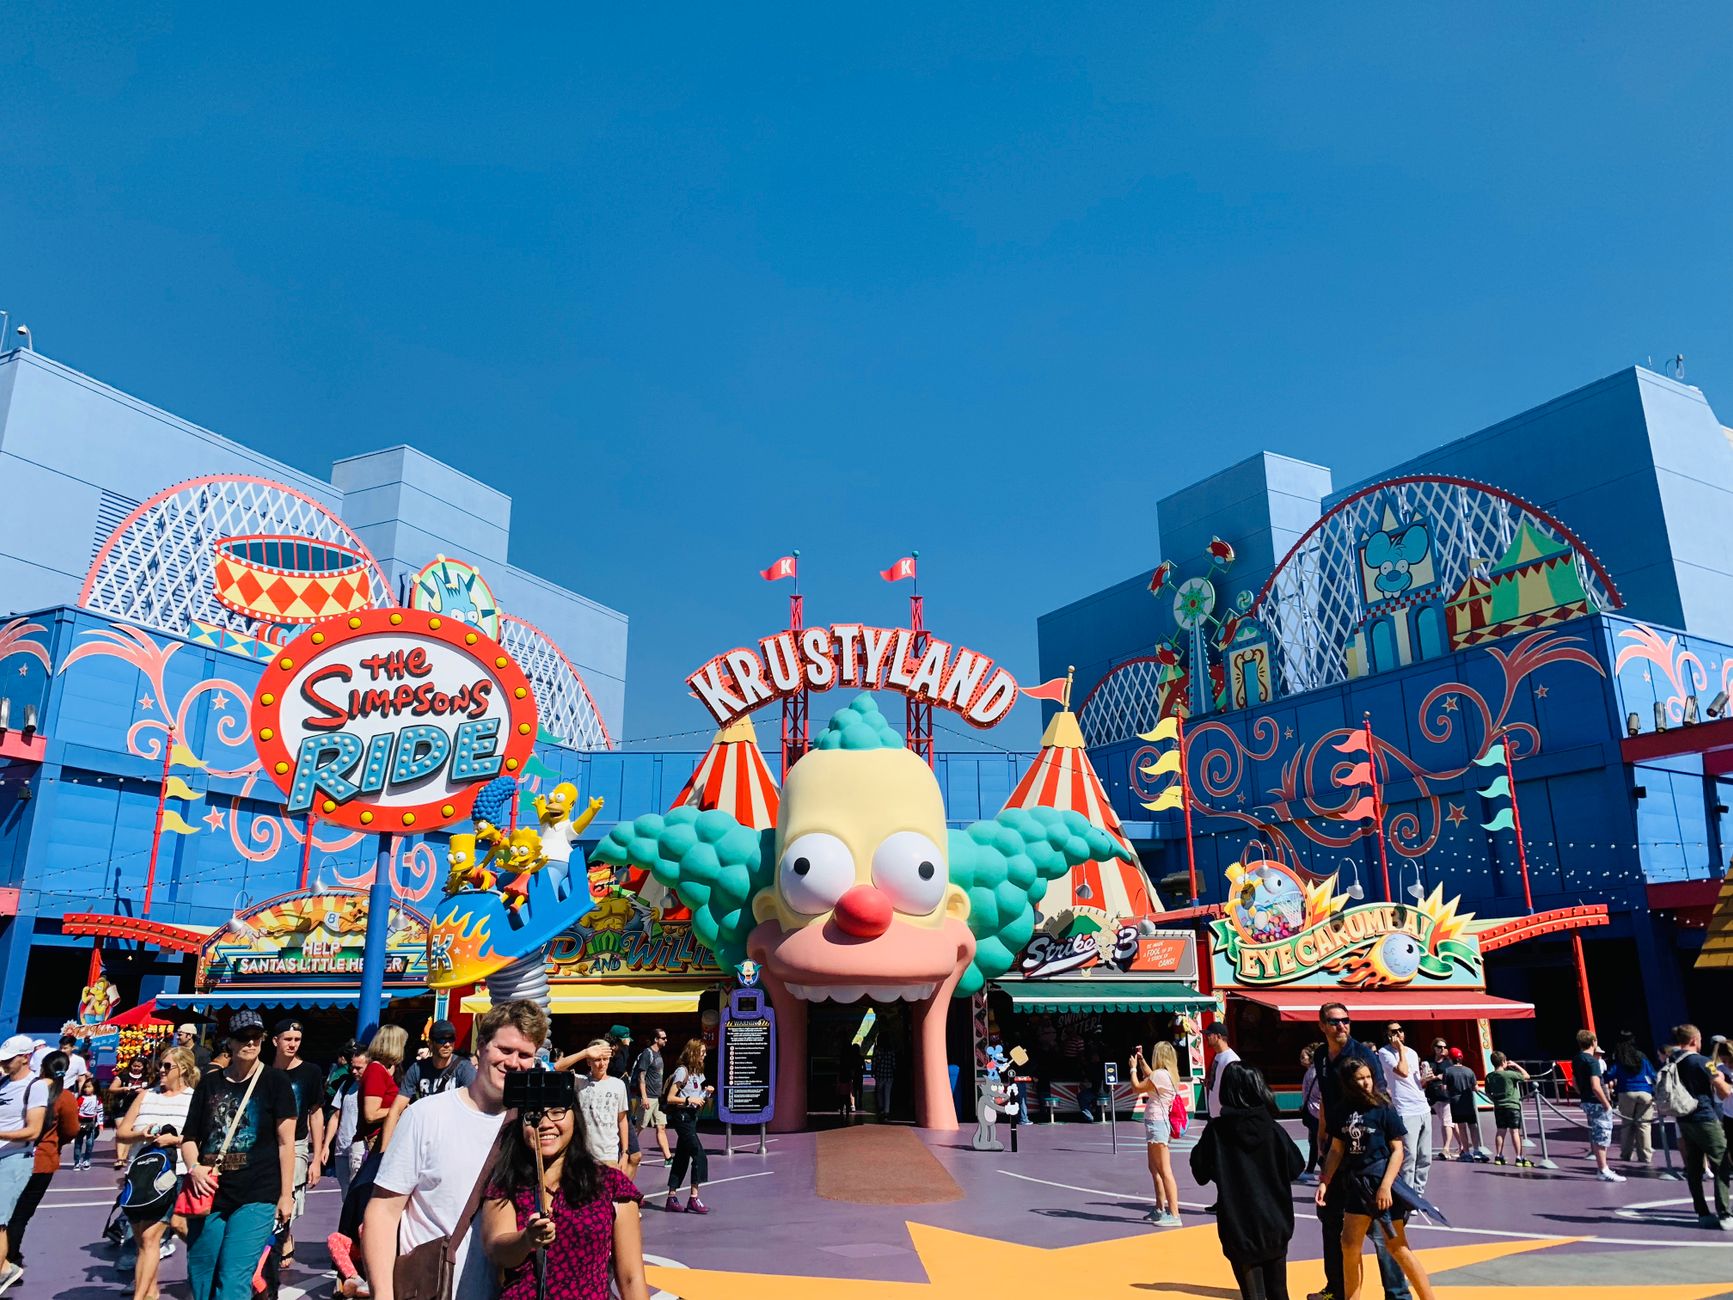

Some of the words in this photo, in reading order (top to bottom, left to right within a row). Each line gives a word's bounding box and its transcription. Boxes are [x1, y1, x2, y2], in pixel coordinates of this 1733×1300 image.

[780, 559, 792, 574] K
[900, 557, 912, 575] K
[686, 624, 1018, 728] KRUSTYLAND
[300, 663, 493, 732] SIMPSONS
[287, 718, 503, 815] RIDE
[327, 913, 337, 924] 8
[302, 941, 342, 959] HELP
[1022, 933, 1097, 969] Strike
[1115, 926, 1139, 960] 3
[1147, 947, 1161, 958] FOOL
[240, 956, 296, 974] SANTA'S
[300, 956, 345, 974] LITTLE
[349, 957, 404, 974] HEER
[588, 953, 622, 975] AND
[1239, 943, 1298, 978] EYE
